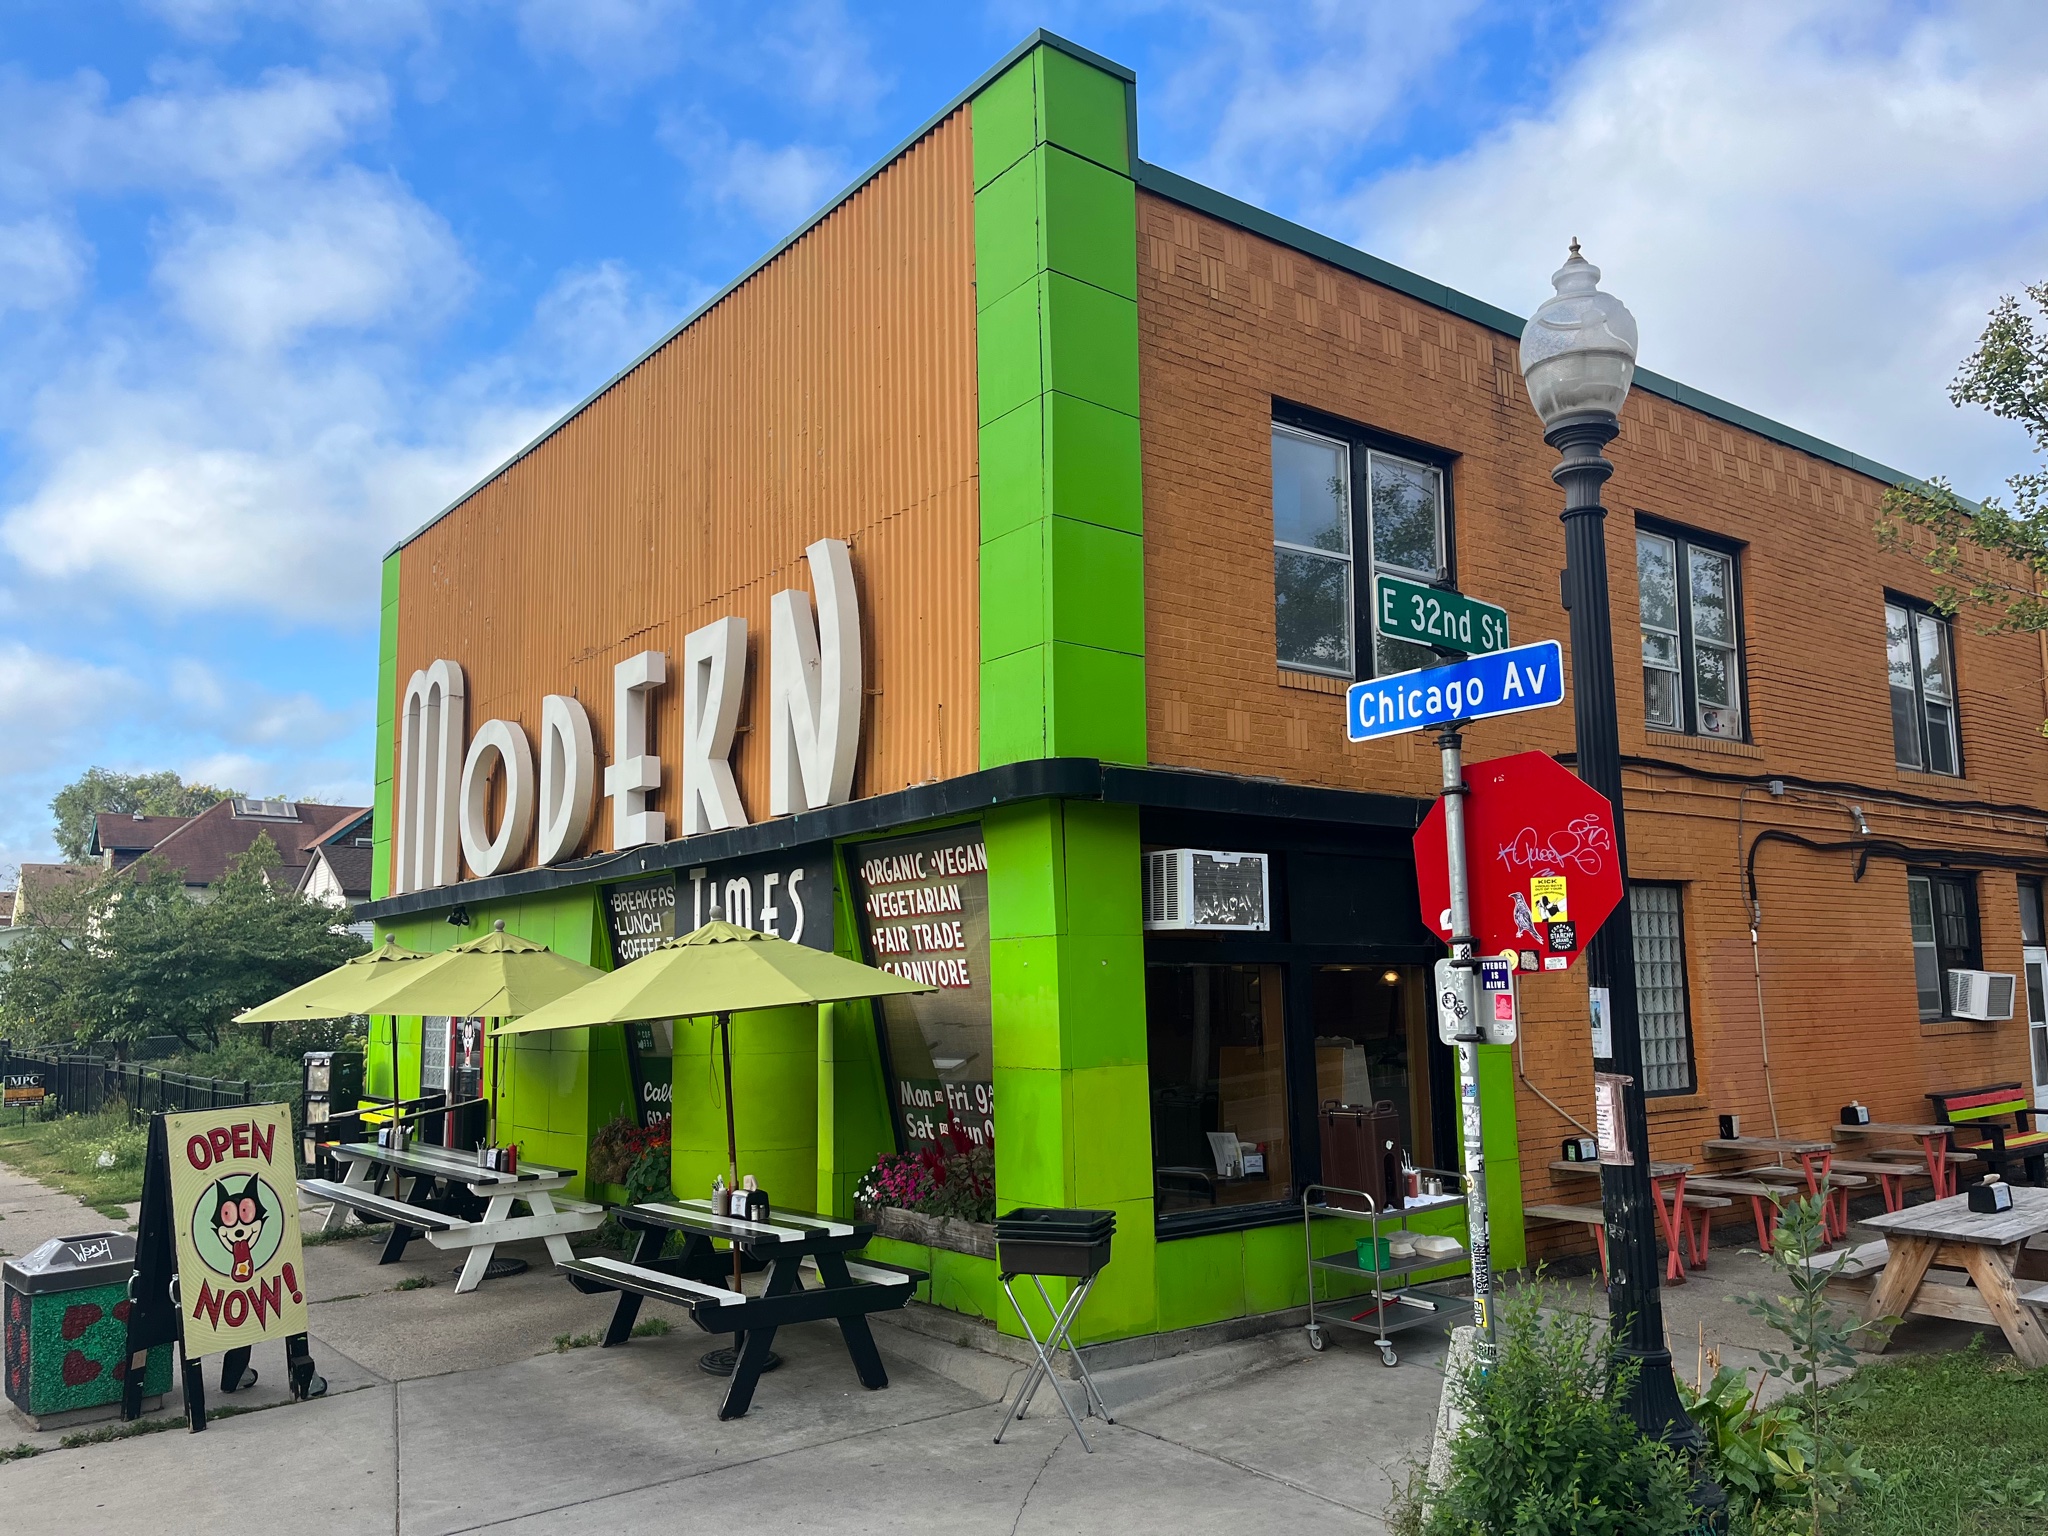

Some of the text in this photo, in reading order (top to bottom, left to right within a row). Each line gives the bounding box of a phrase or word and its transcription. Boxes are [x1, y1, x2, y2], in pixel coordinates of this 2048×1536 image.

[1382, 587, 1504, 650] E 32nd St
[1359, 661, 1547, 728] Chicago Av
[865, 843, 988, 886] ORGANIC VEGAN
[613, 886, 676, 913] BREAKFAS
[870, 884, 962, 918] VEGETARIAN
[616, 911, 662, 936] LUNCH
[876, 921, 965, 953] FAIR TRADE
[1486, 981, 1505, 989] ALIVE
[1491, 971, 1499, 979] IS
[10, 1076, 39, 1086] MPC
[900, 1081, 935, 1108] Mon.
[945, 1083, 974, 1111] Fri.
[906, 1113, 935, 1140] Sat
[187, 1119, 276, 1171] OPEN
[192, 1262, 304, 1332] NOW!
